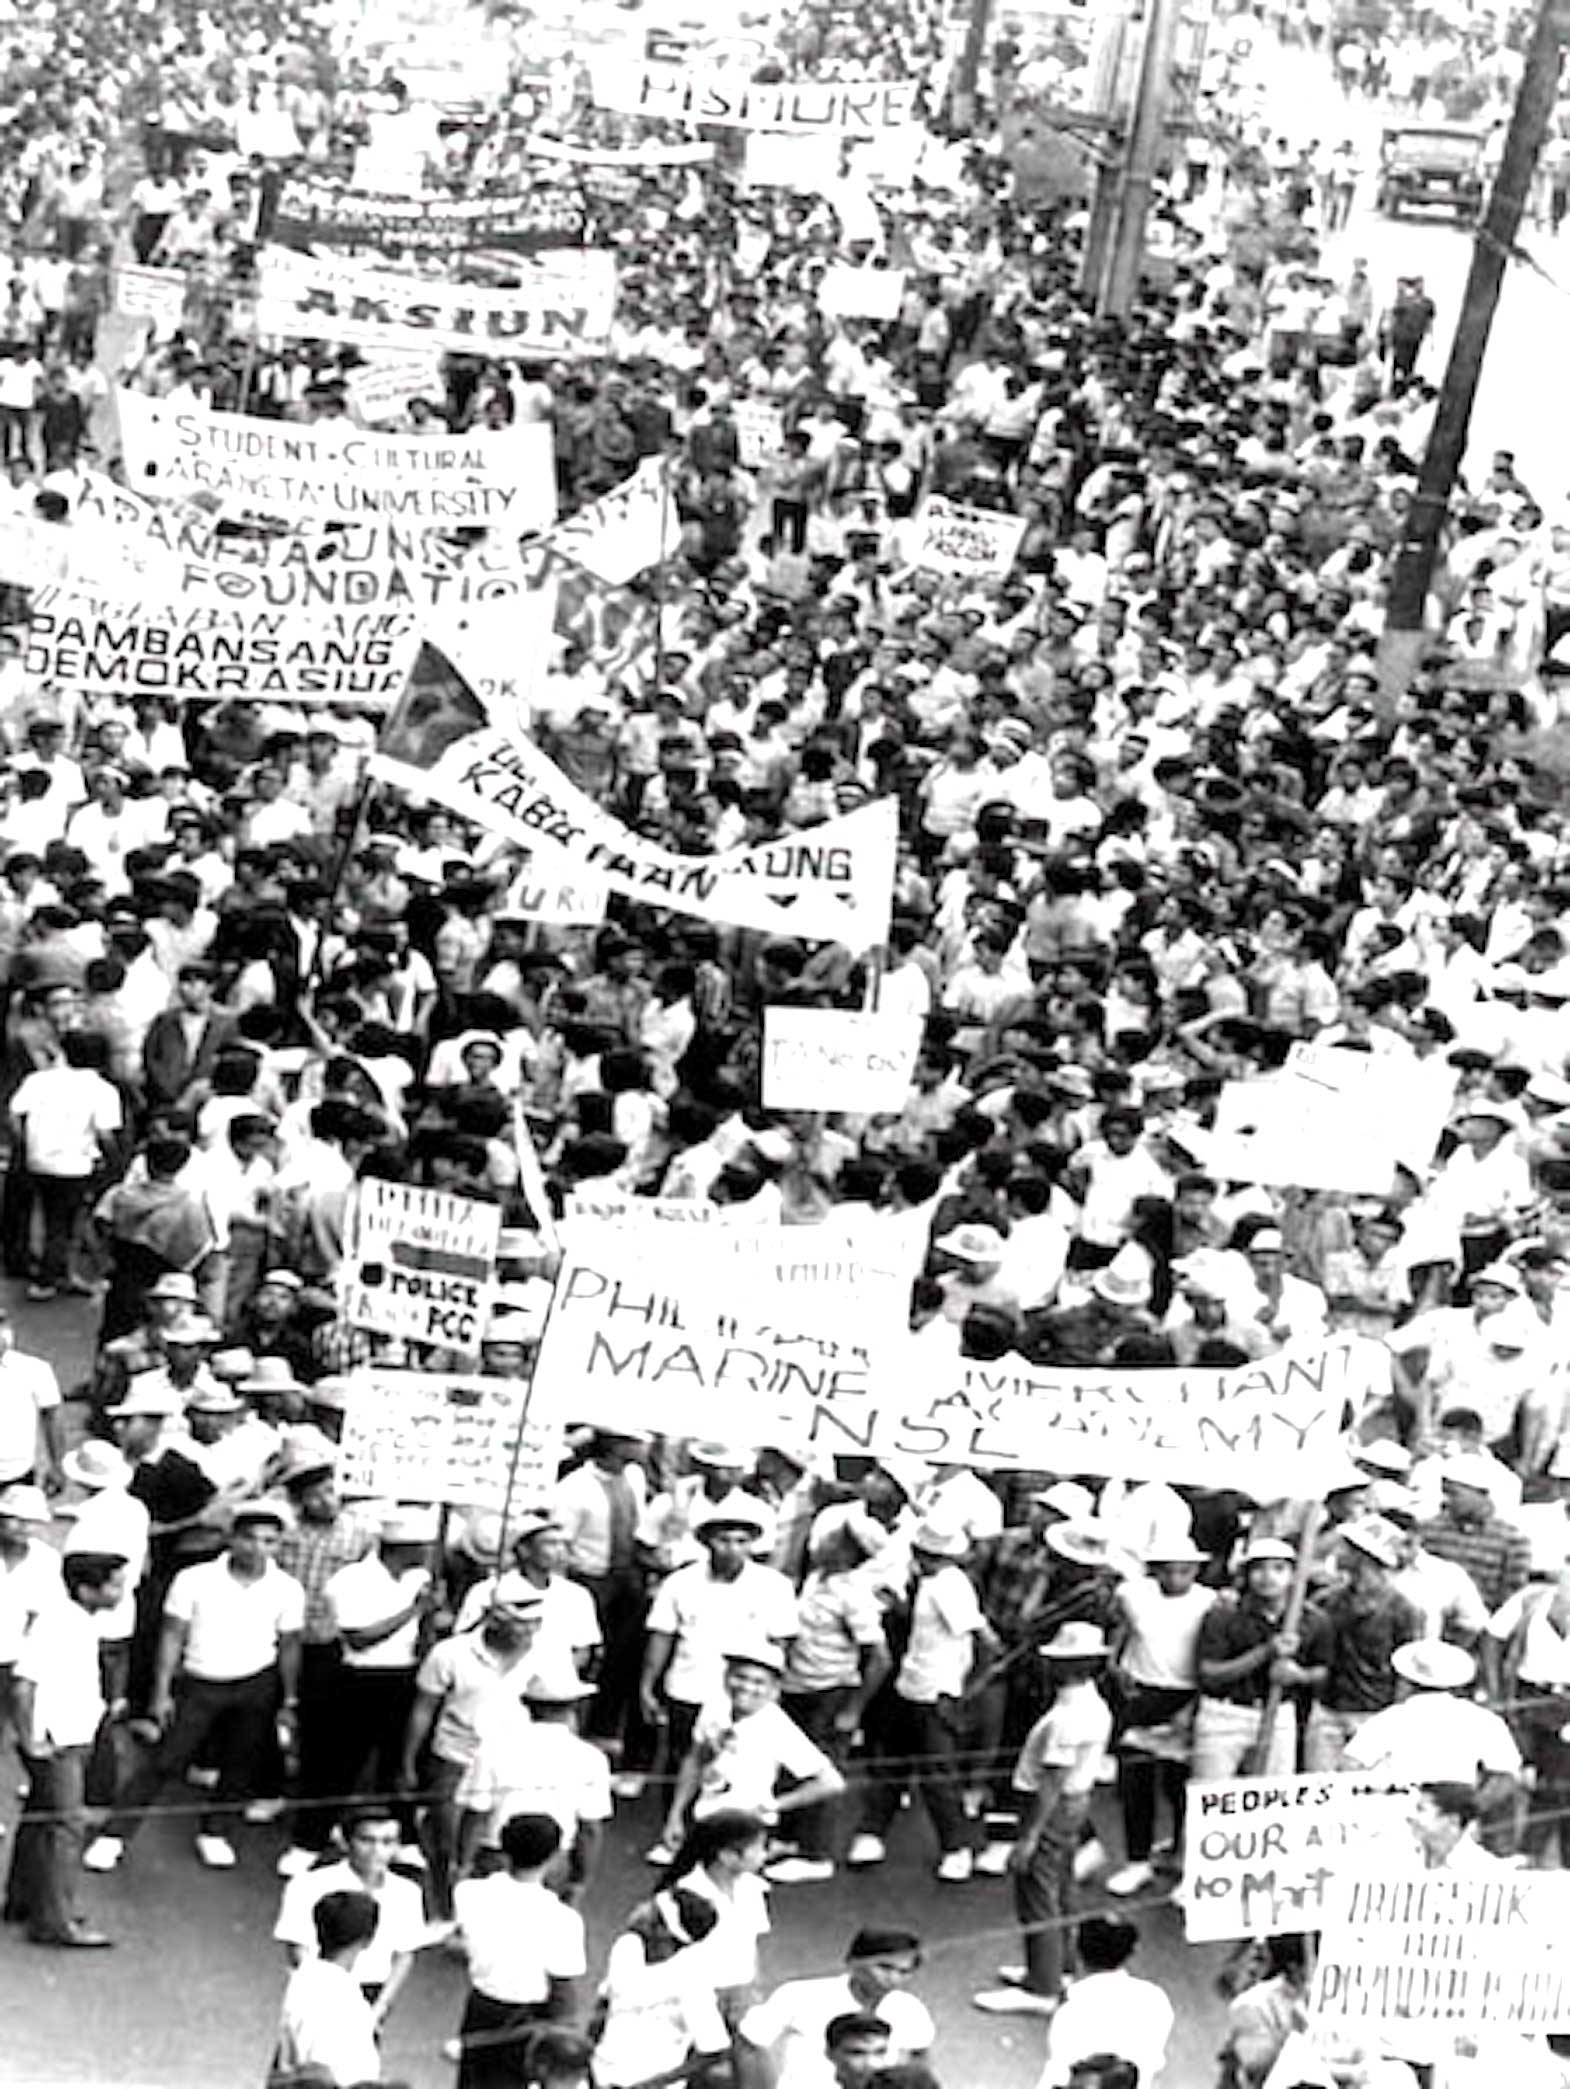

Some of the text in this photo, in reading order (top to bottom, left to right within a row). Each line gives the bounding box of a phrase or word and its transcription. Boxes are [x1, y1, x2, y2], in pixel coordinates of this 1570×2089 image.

[175, 414, 318, 463] STUDENT
[333, 484, 517, 519] UNIVERSITY
[30, 612, 394, 668] PAMBANSANG
[586, 1330, 869, 1401] MARINE
[1199, 1823, 1289, 1861] OUR
